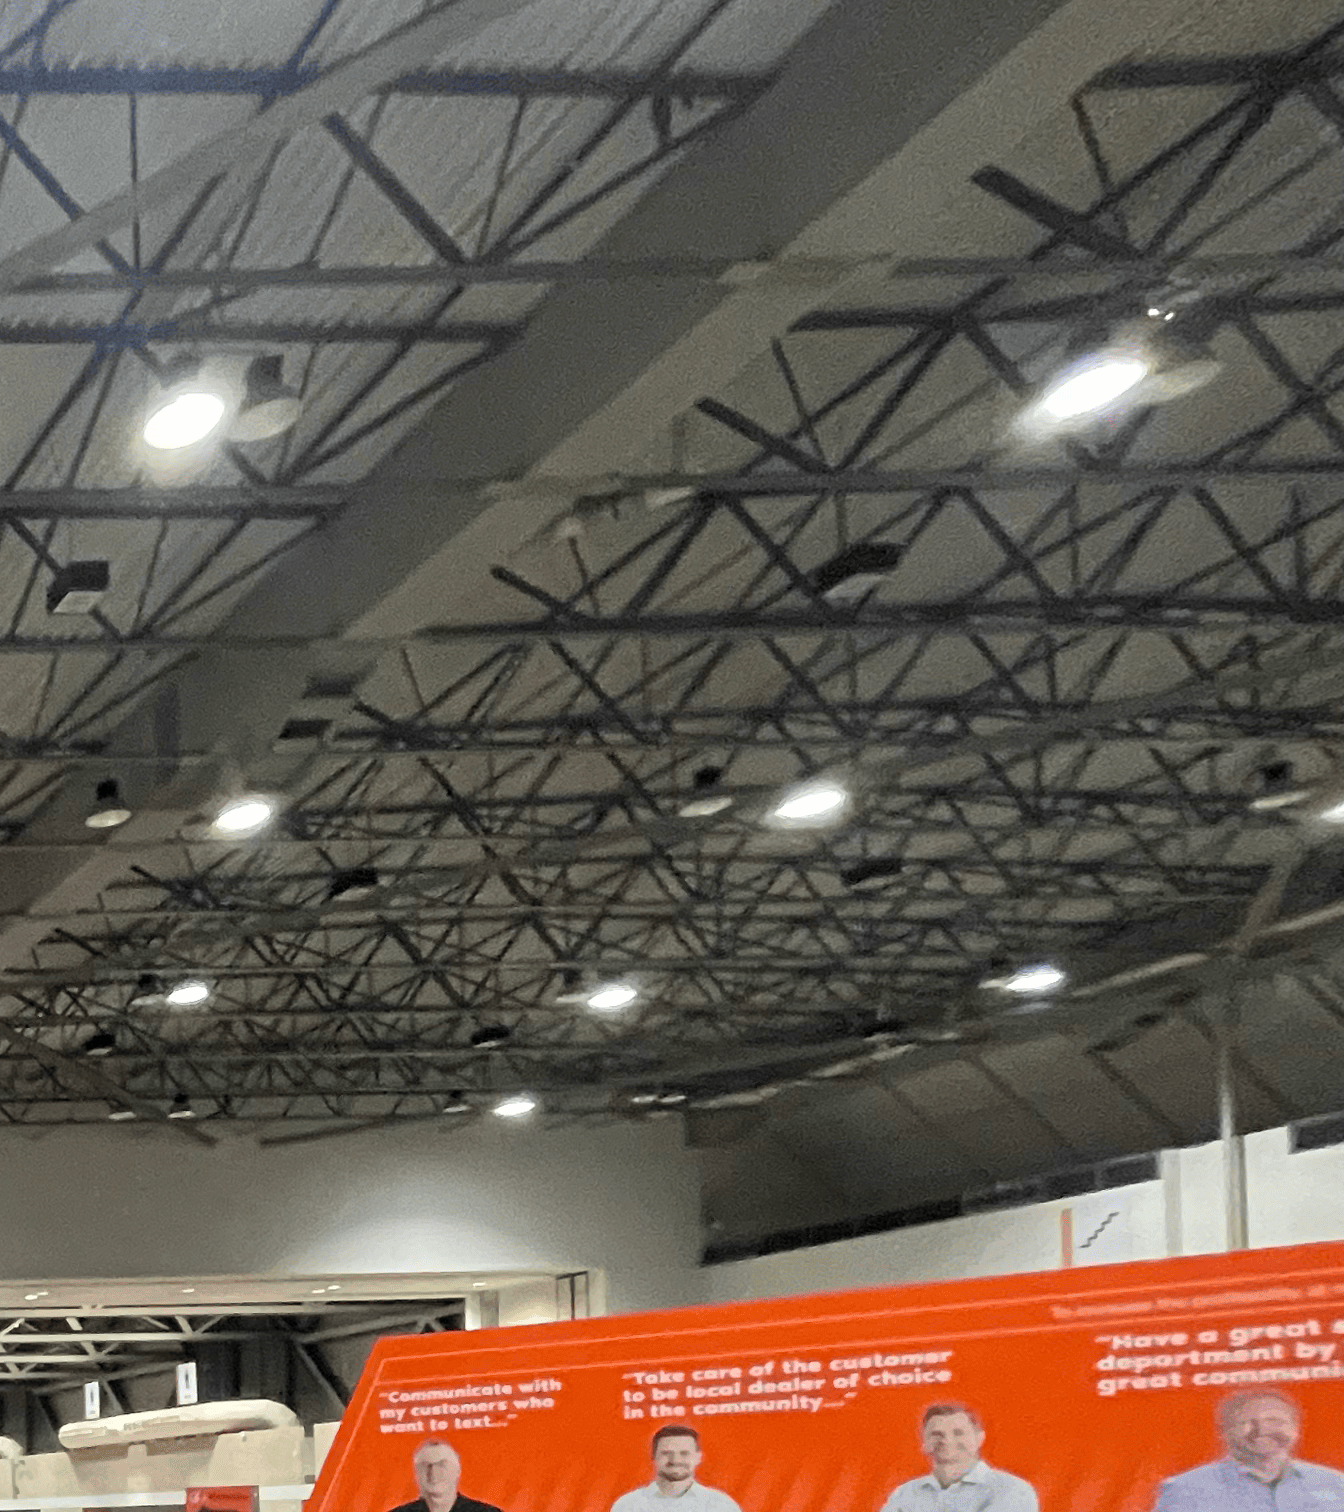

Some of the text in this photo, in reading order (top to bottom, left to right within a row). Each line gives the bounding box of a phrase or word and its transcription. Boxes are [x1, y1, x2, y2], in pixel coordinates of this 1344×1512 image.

[1197, 1330, 1218, 1343] a
[1229, 1319, 1322, 1347] great
[692, 1366, 742, 1382] care
[749, 1360, 775, 1377] of
[782, 1358, 822, 1374] the
[830, 1350, 953, 1371] customer
[1095, 1341, 1337, 1373] department by
[518, 1377, 562, 1393] with
[624, 1367, 952, 1403] to be local dealer of choice
[1097, 1371, 1183, 1396] great
[379, 1396, 555, 1421] my customers who
[624, 1404, 644, 1420] in
[650, 1403, 685, 1418] the
[380, 1420, 424, 1434] want
[430, 1419, 448, 1431] to
